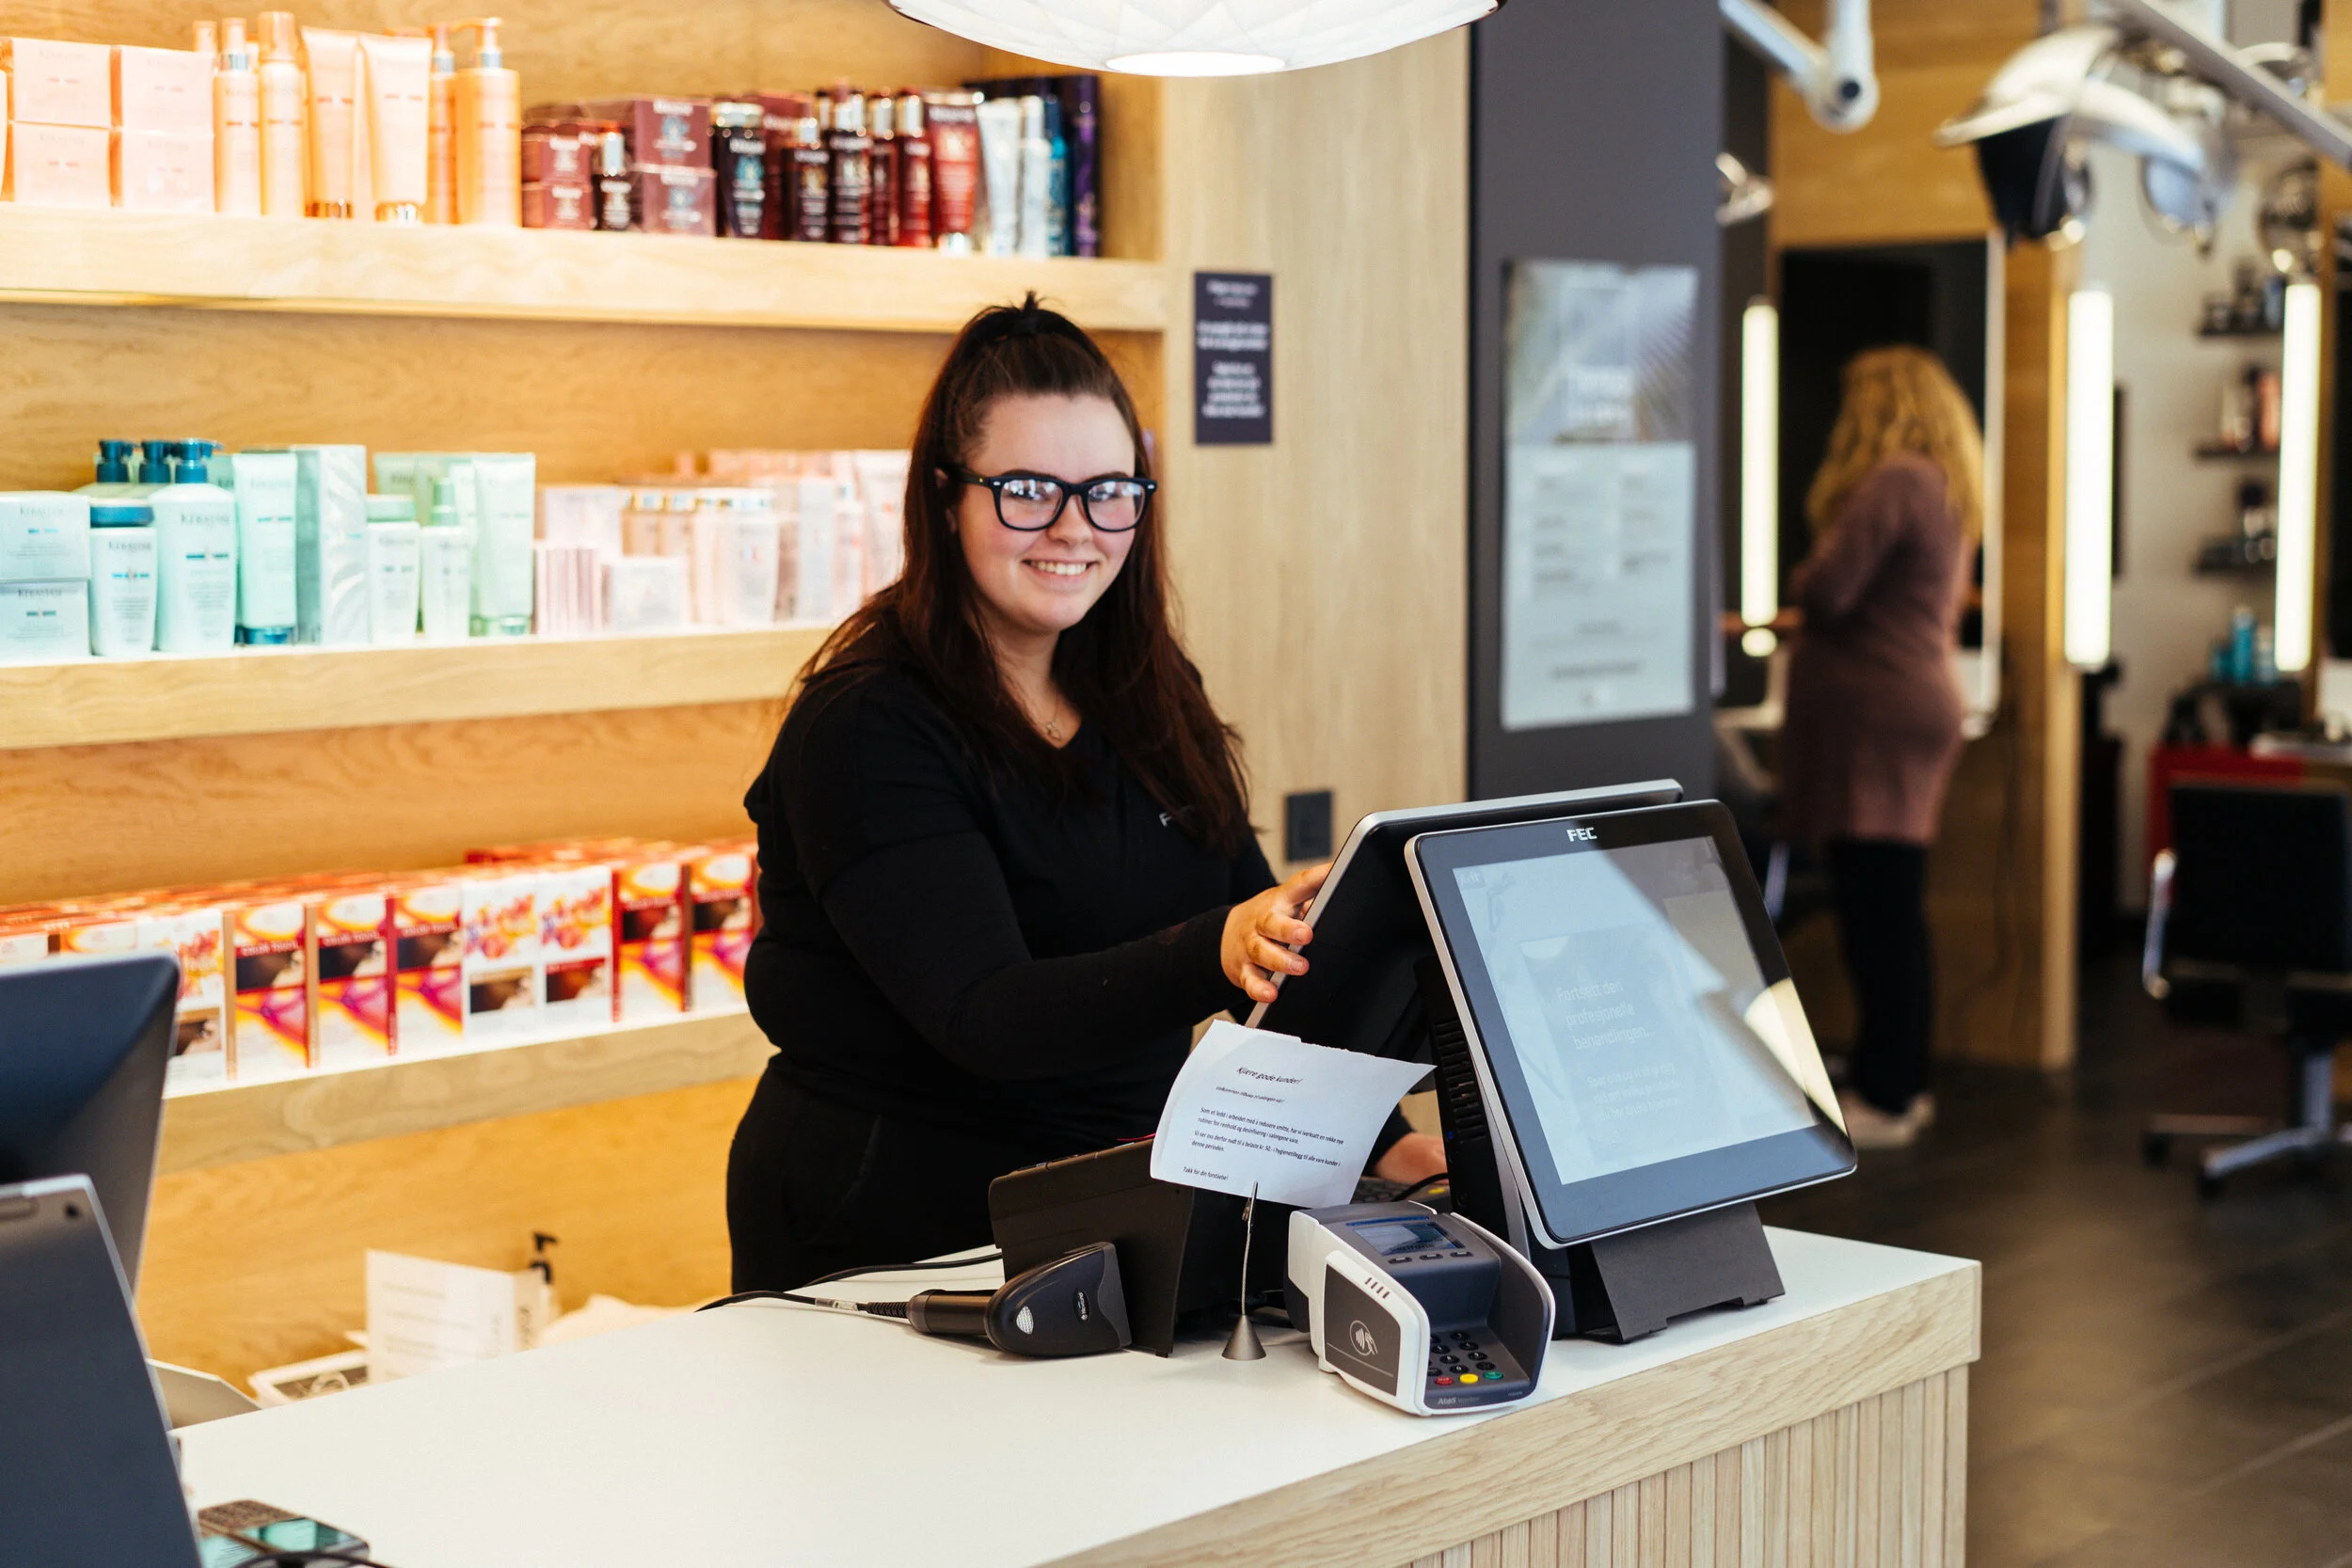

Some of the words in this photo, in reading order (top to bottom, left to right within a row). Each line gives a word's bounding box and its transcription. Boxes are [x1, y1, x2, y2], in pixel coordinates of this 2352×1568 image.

[1565, 827, 1597, 842] FEC
[1604, 980, 1624, 995] den
[1229, 1114, 1246, 1122] arbeidet
[1302, 1131, 1320, 1139] iverksatt
[1269, 1132, 1289, 1141] salongene
[1245, 1141, 1259, 1149] belaste
